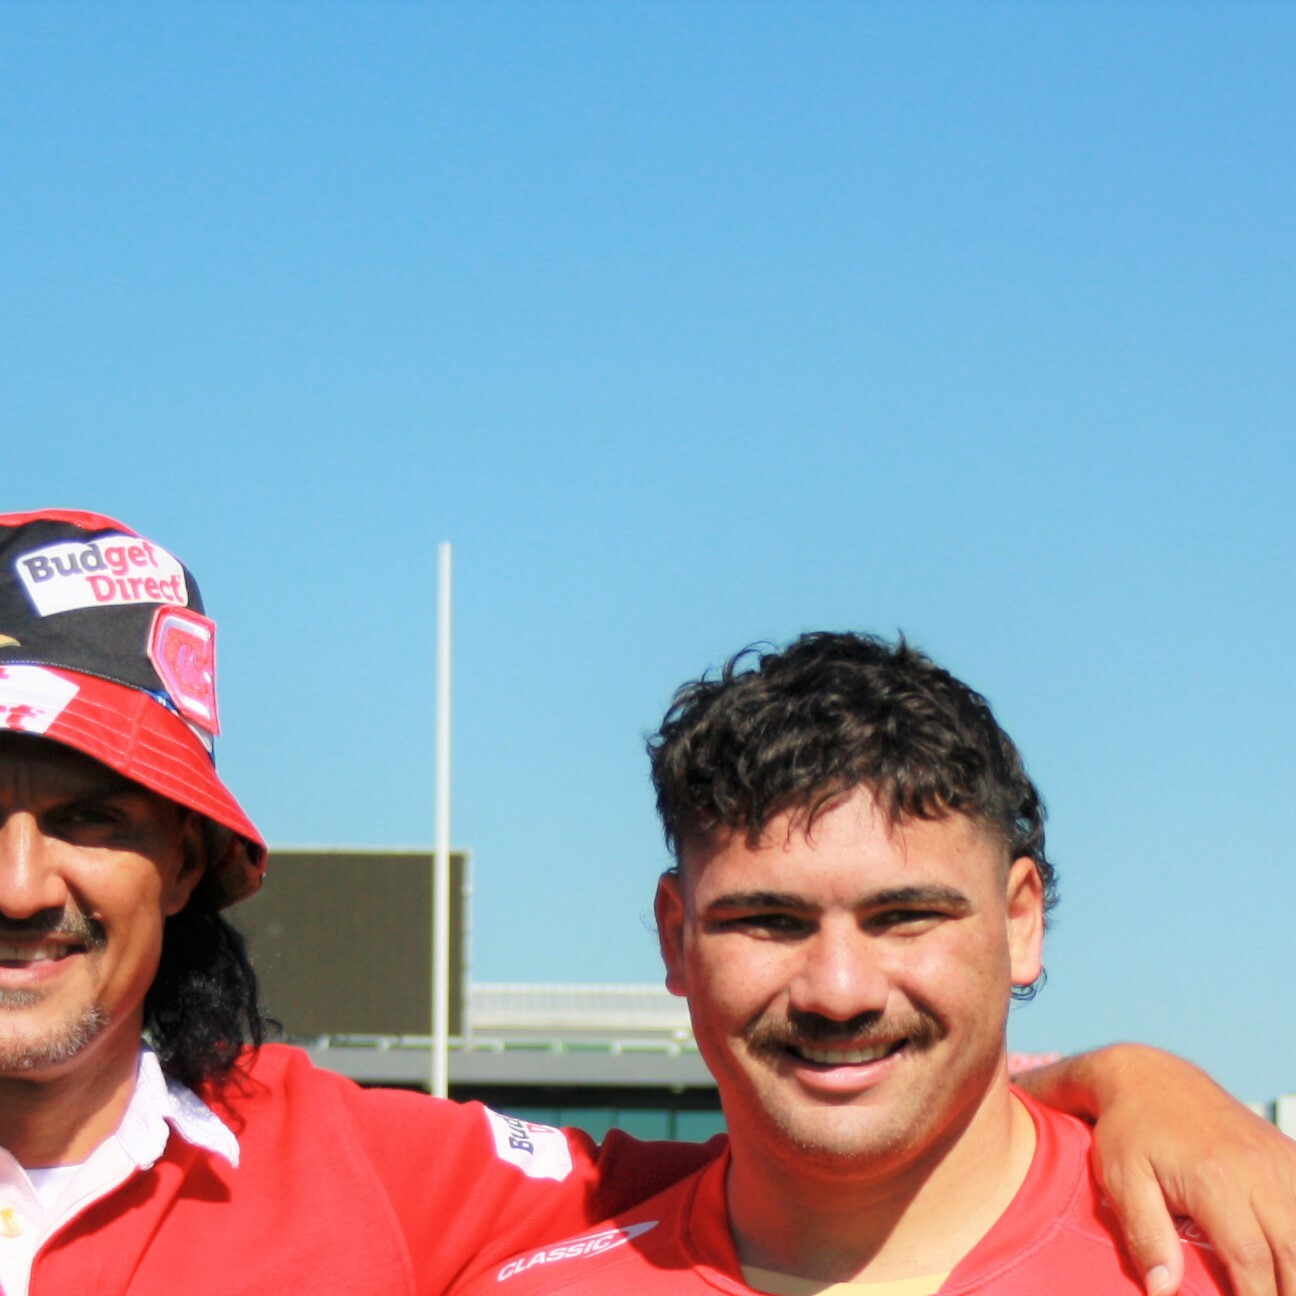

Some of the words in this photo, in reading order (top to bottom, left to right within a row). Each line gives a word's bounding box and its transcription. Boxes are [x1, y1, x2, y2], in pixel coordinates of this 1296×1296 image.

[23, 542, 159, 583] Budget
[86, 573, 183, 604] Direct
[497, 1234, 615, 1282] CLASSIC
